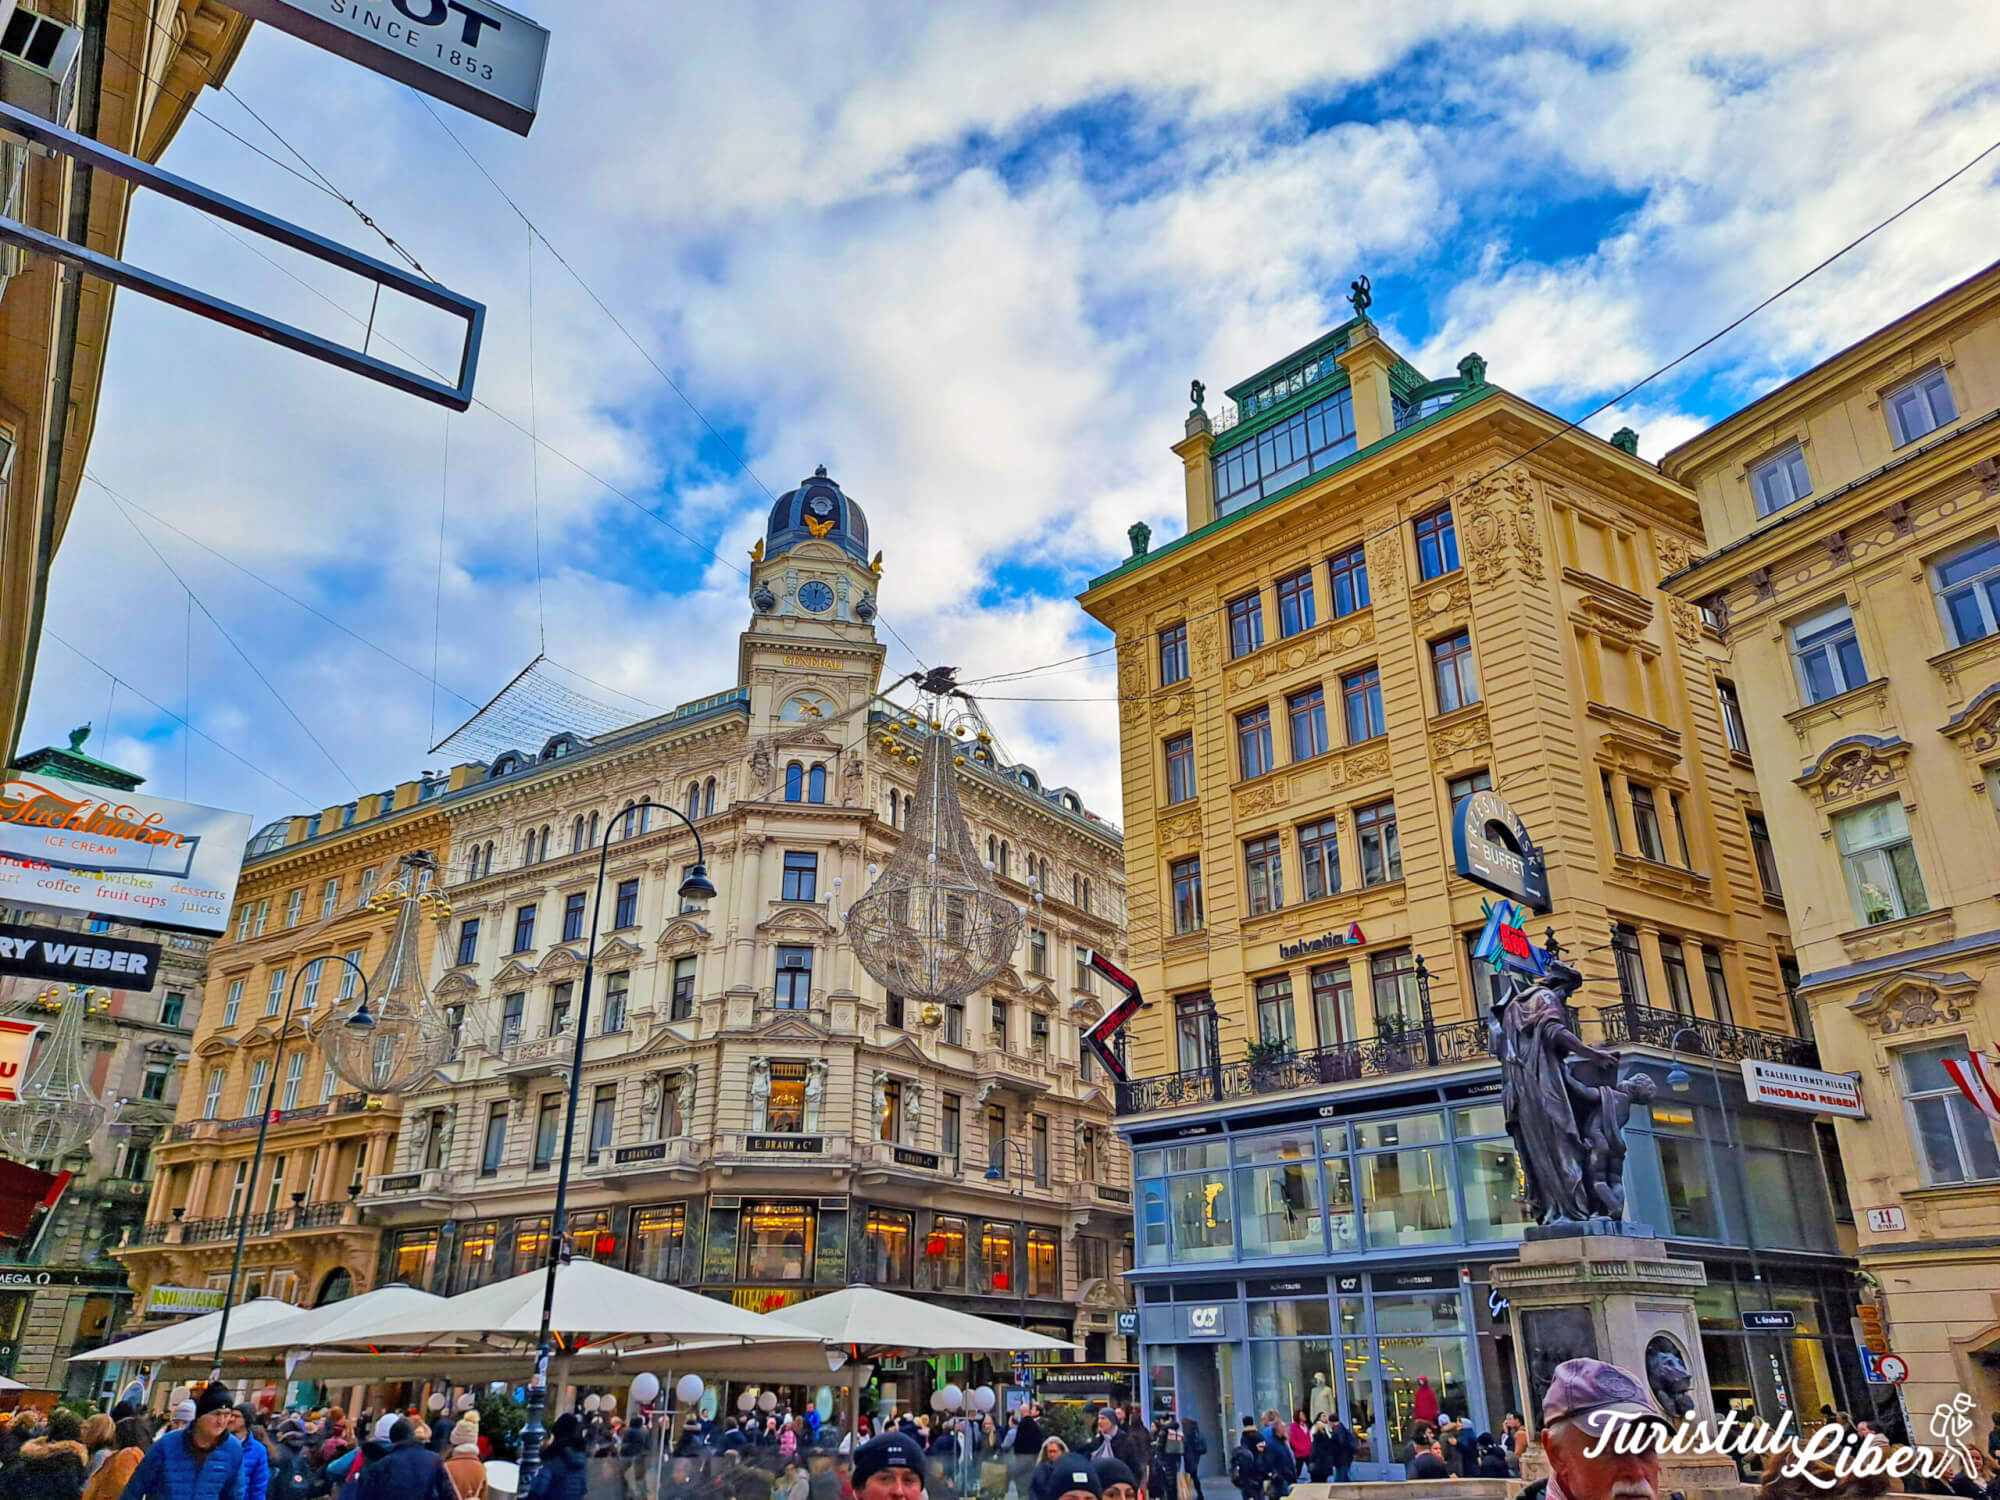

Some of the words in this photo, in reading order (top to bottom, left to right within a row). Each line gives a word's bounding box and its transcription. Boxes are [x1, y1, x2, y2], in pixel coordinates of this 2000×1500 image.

[330, 0, 420, 48] SINCE
[435, 43, 494, 81] 1853
[783, 655, 843, 671] GENERALI
[0, 780, 186, 849] Tuchlauben
[45, 836, 66, 848] ICE
[71, 840, 118, 856] CREAM
[1482, 844, 1525, 877] BUFFET
[36, 877, 81, 894] coffee
[96, 885, 129, 902] fruit
[133, 893, 167, 909] cups
[179, 899, 221, 915] juices
[69, 867, 154, 889] sandwiches
[170, 881, 226, 901] desserts
[0, 936, 37, 960] RY
[42, 941, 149, 974] WEBER
[1279, 931, 1346, 959] helvetia
[1764, 1069, 1798, 1083] GALERIE
[1799, 1075, 1824, 1087] ERNST
[1825, 1079, 1853, 1091] HILGER
[1819, 1095, 1857, 1108] REISEN
[765, 1140, 795, 1150] BRAUN
[1879, 1209, 1893, 1224] 11
